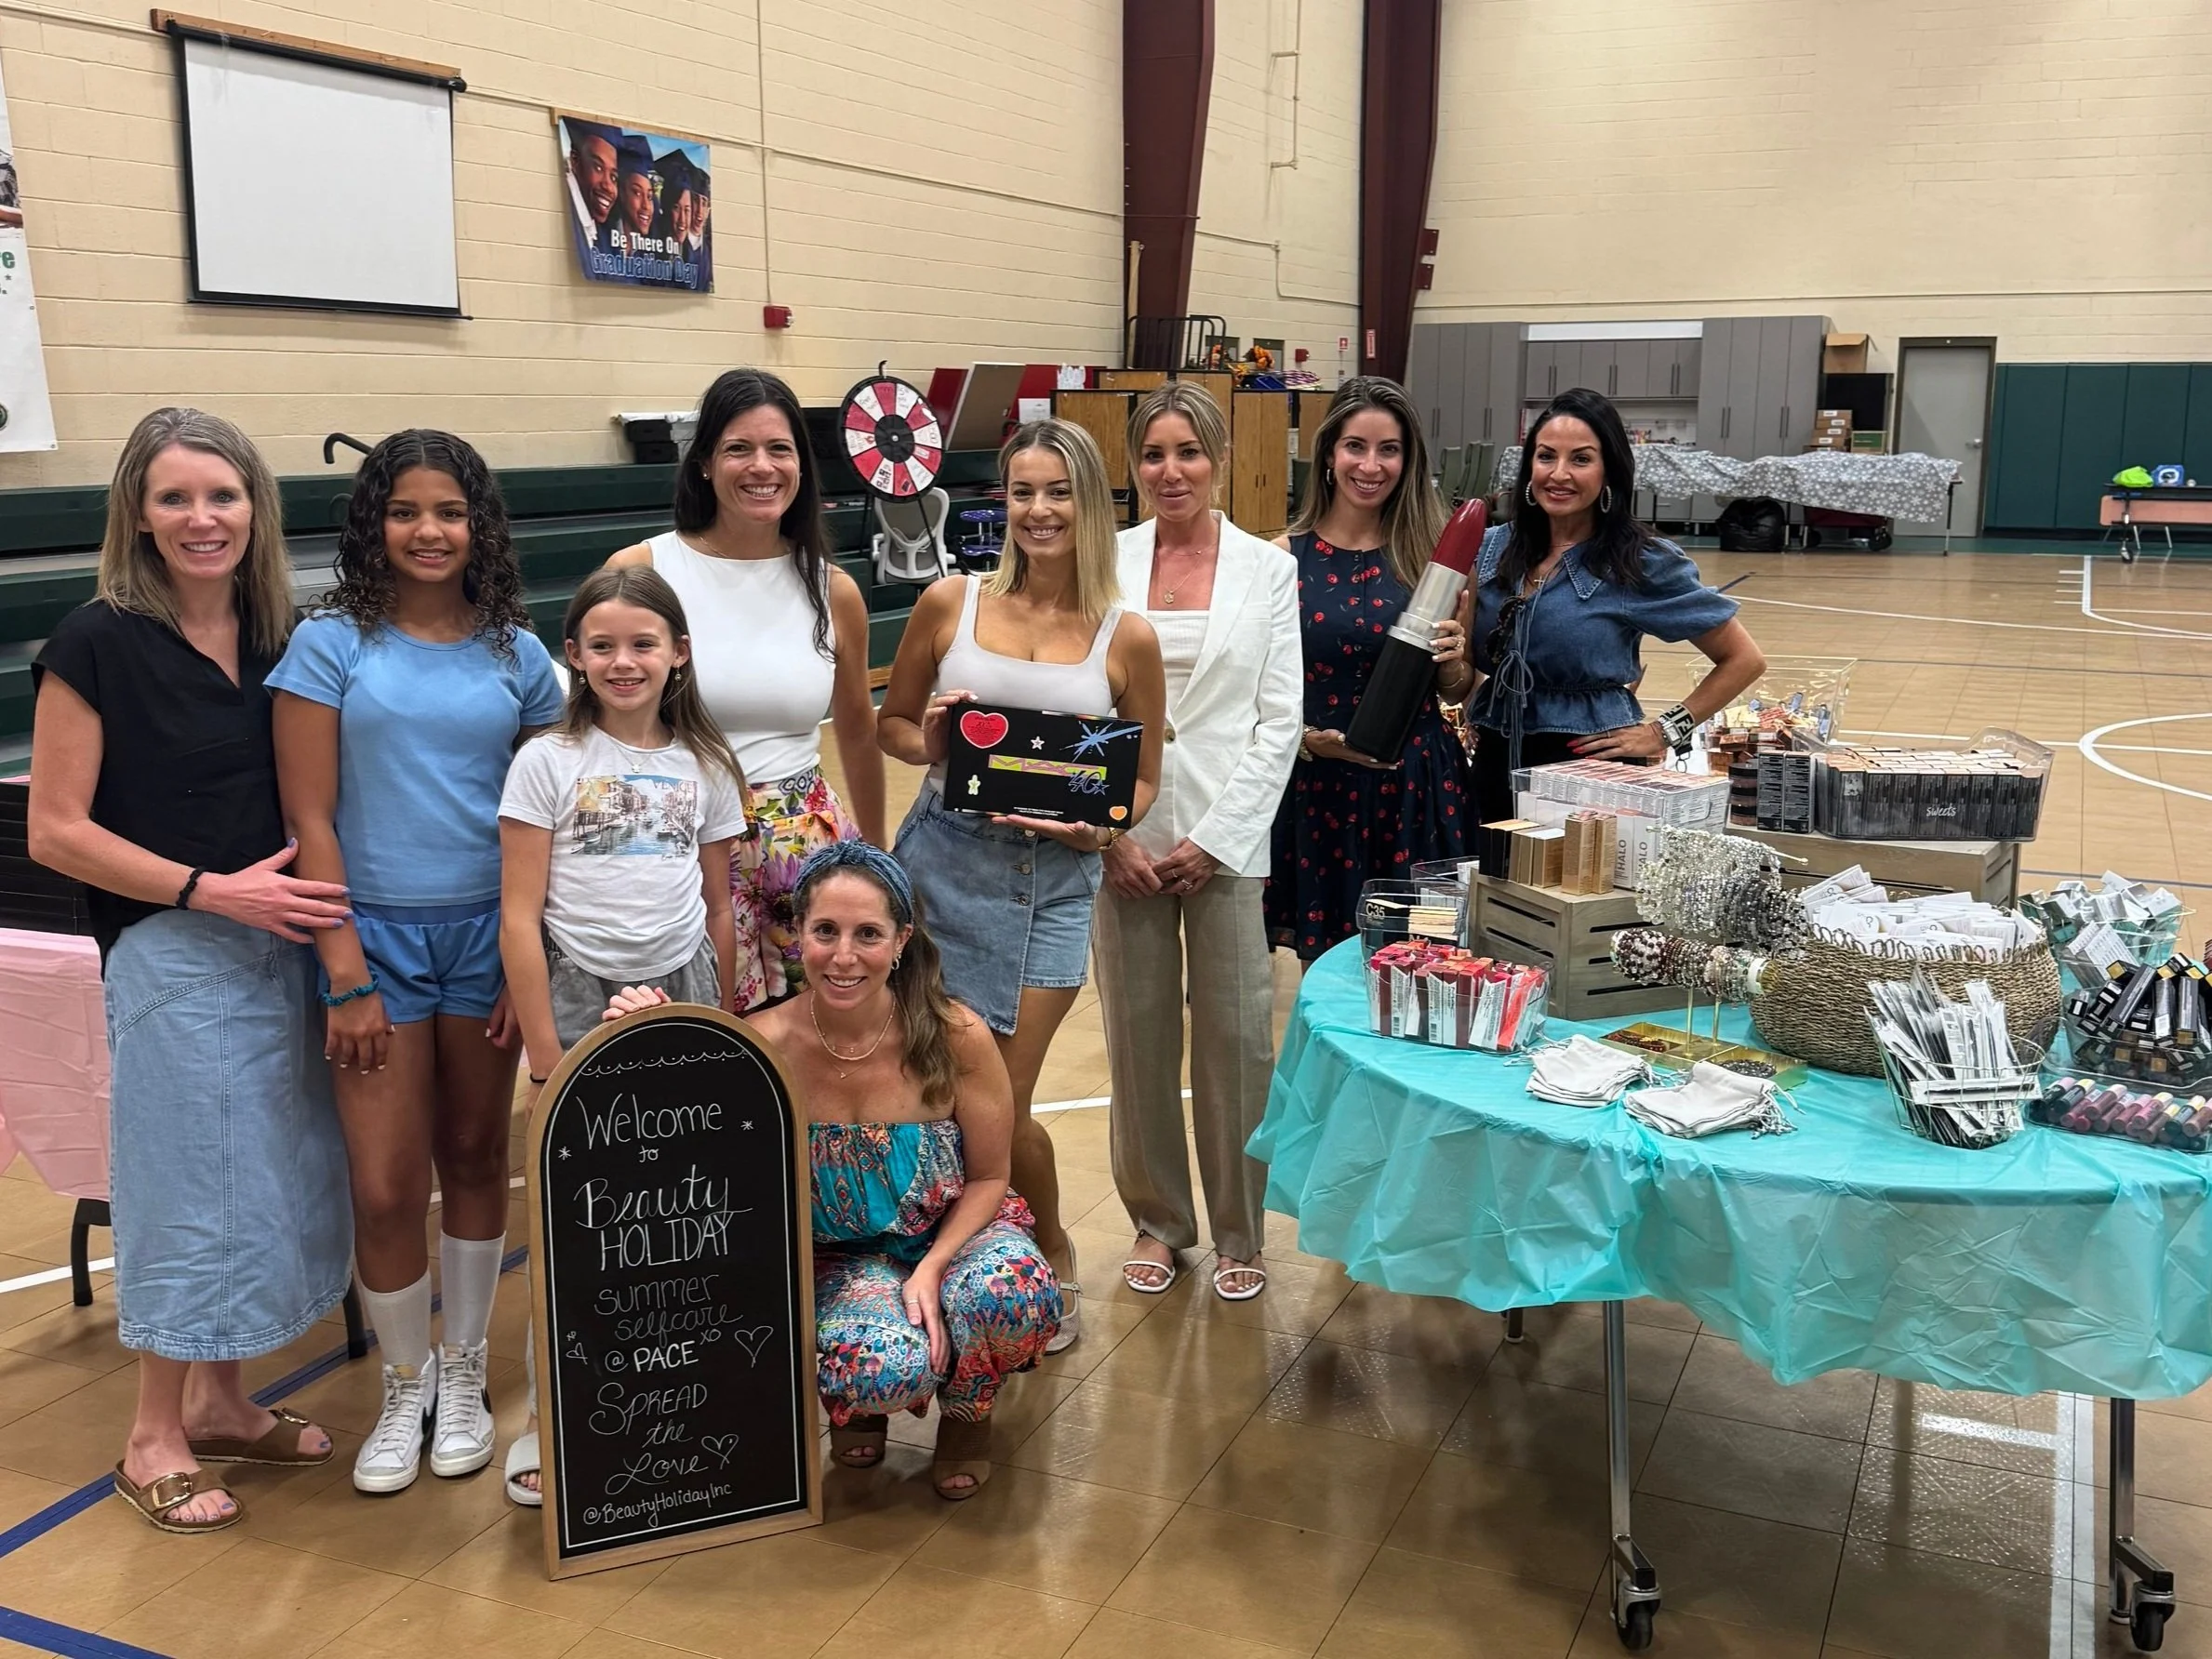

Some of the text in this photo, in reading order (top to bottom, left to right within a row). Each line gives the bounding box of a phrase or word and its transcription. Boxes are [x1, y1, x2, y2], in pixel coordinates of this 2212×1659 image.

[610, 230, 680, 255] Be There On
[591, 246, 699, 289] Graduation Day
[1617, 840, 1627, 870] HALO
[1366, 903, 1385, 919] C35
[576, 1093, 723, 1150] Welcome
[638, 1146, 660, 1162] to
[573, 1164, 753, 1232] Beauty
[600, 1214, 730, 1271] HOLIDAY
[605, 1340, 700, 1373] @ PACE
[641, 1418, 694, 1449] the
[605, 1453, 709, 1495] Love
